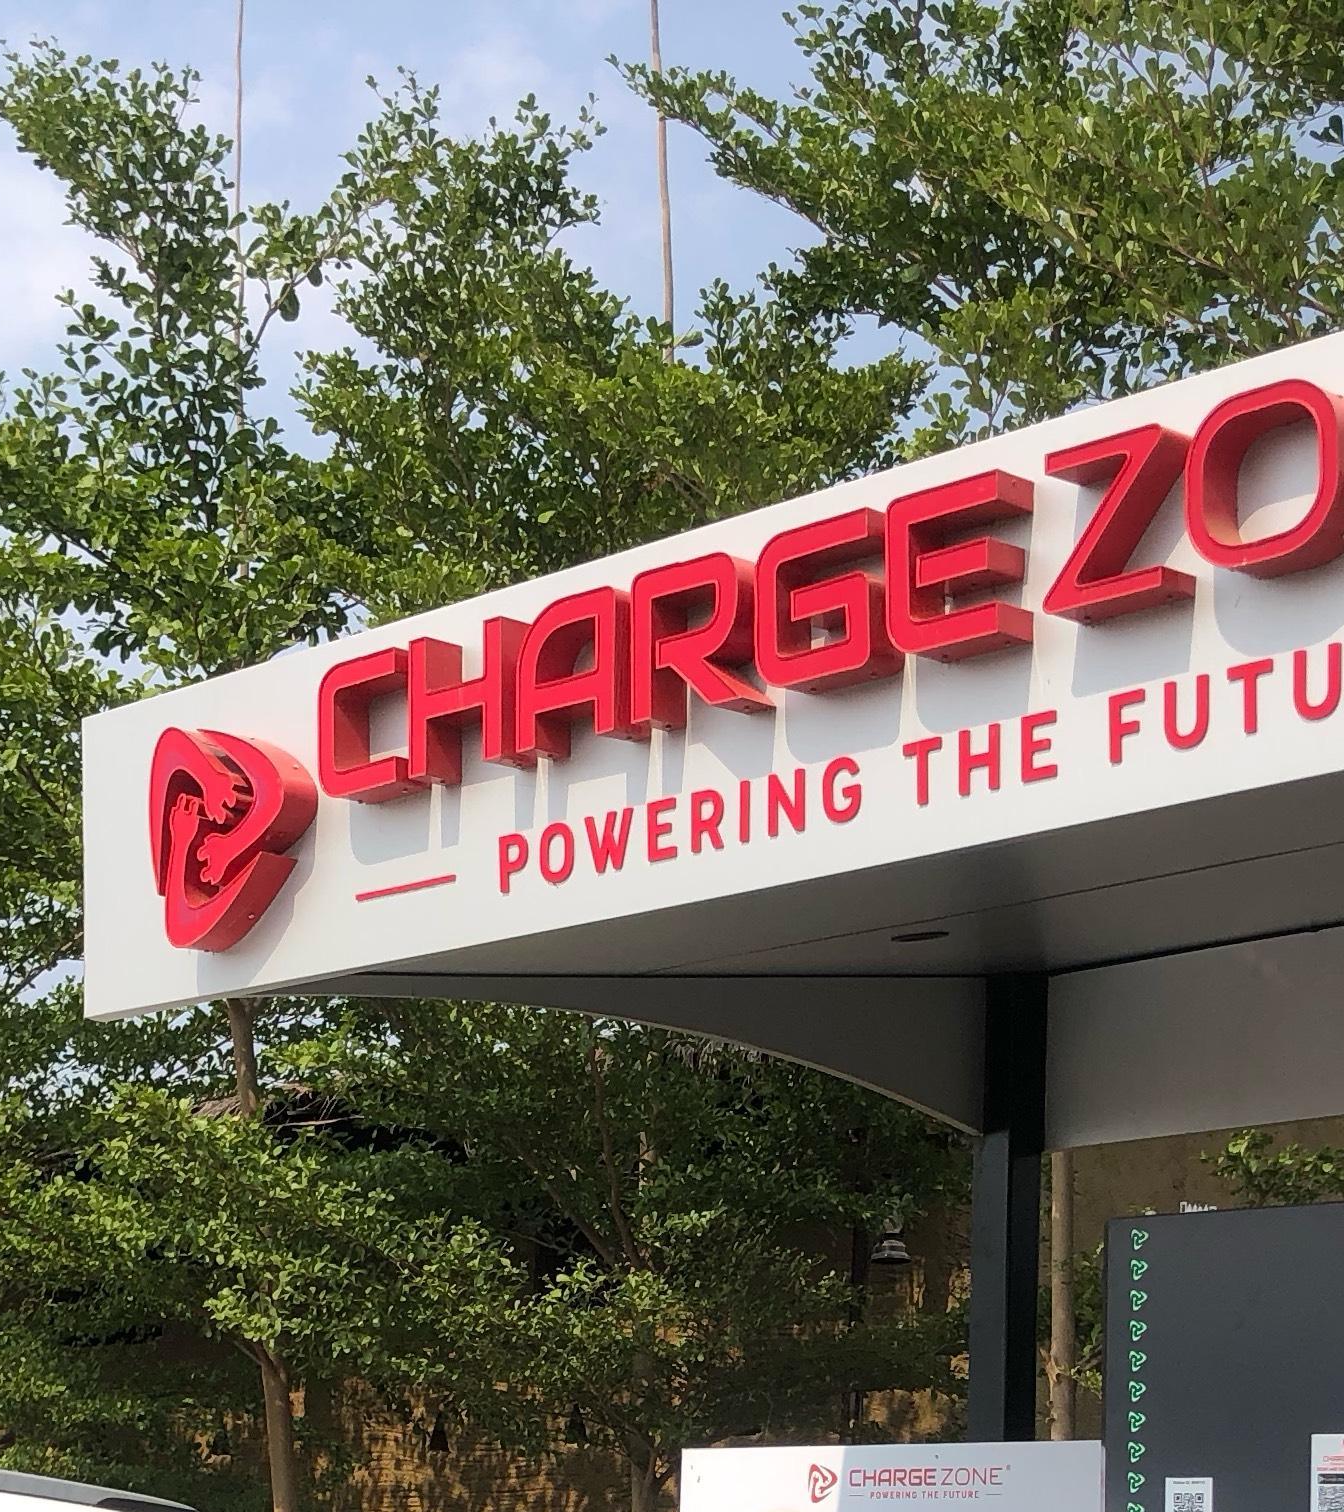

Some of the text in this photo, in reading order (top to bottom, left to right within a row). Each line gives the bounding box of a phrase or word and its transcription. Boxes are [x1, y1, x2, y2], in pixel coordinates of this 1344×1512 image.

[500, 757, 862, 893] POWERING
[904, 710, 1060, 807] THE
[870, 1490, 980, 1500] POWERING THE FUTURE
